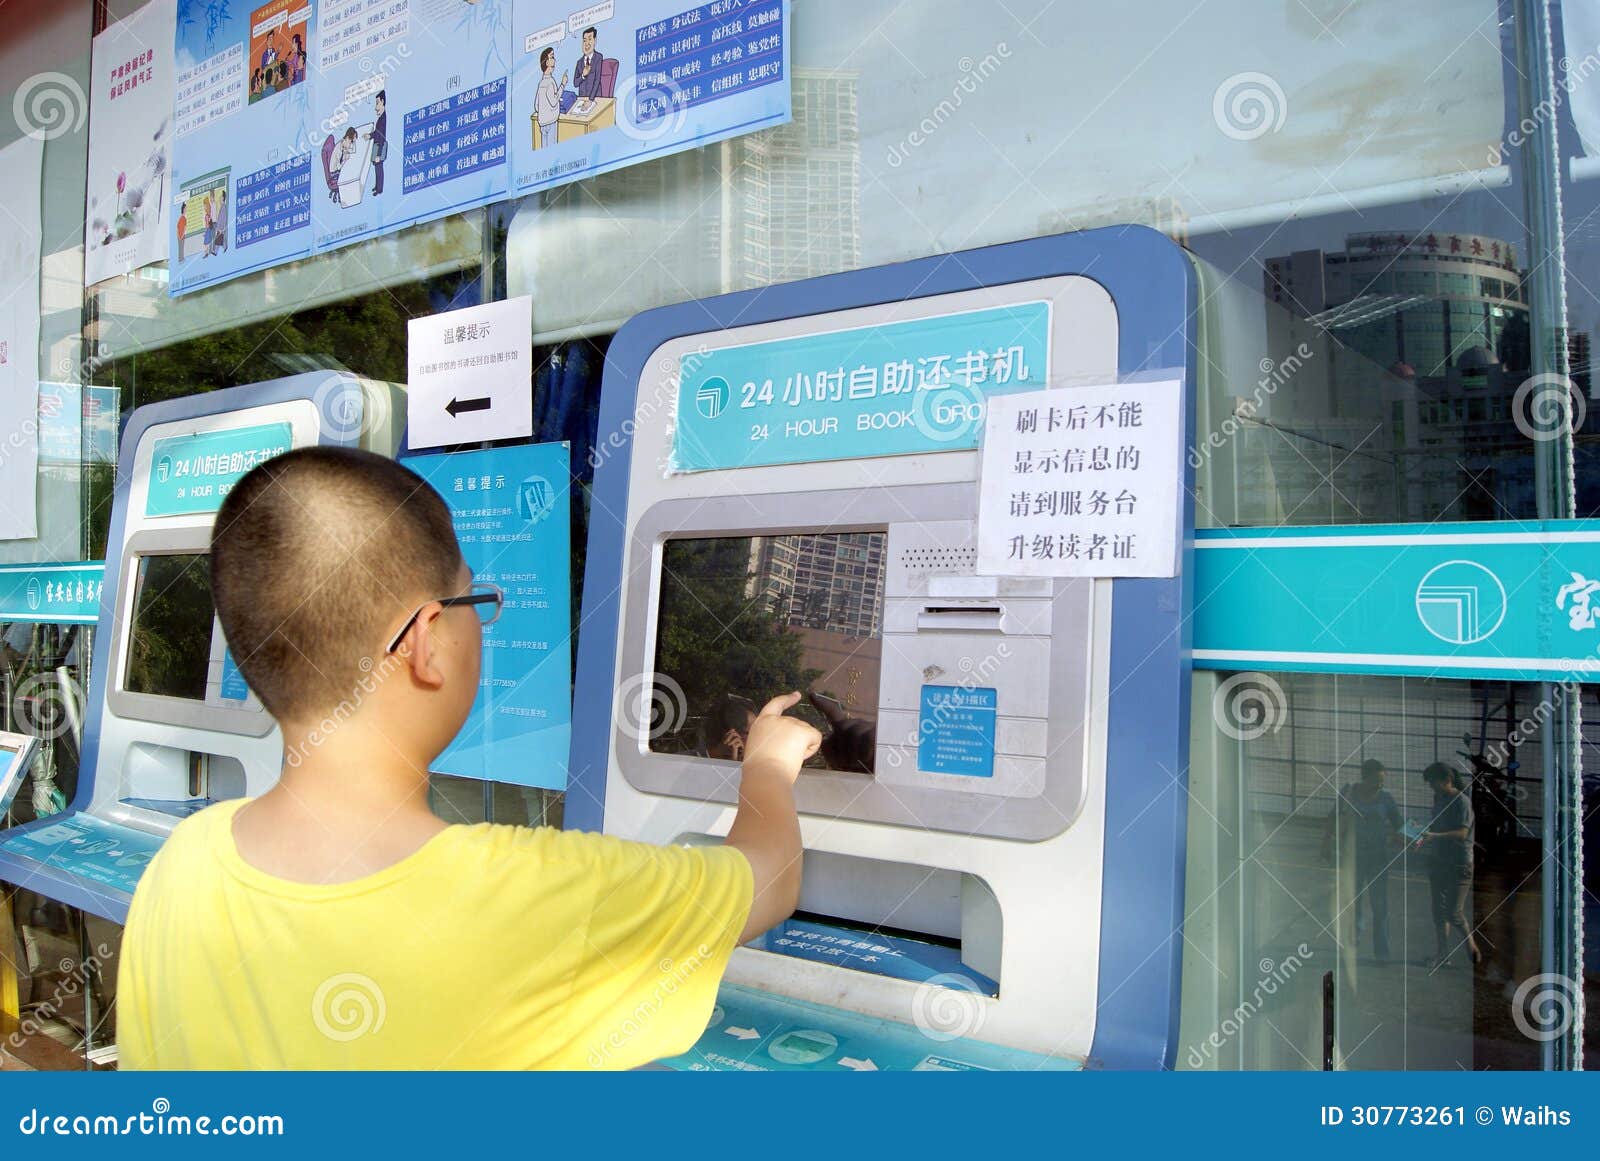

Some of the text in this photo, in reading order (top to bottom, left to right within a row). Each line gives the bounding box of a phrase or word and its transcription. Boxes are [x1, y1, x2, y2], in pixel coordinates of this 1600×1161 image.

[671, 35, 701, 54] 识利害
[711, 20, 742, 42] 高压线
[711, 47, 743, 67] 经考验
[748, 34, 780, 55] 鉴党性
[711, 72, 743, 93] 信组织
[748, 61, 780, 81] 忠职守
[444, 321, 491, 344] 温馨提示
[740, 345, 1028, 409] 24 小时自助还书机
[751, 425, 769, 441] 24
[785, 417, 838, 437] HOUR
[857, 408, 915, 431] BOOK
[1016, 401, 1142, 434] 刷卡后不能
[175, 460, 190, 478] 24
[1013, 445, 1140, 474] 显示信息的
[177, 487, 185, 499] 24
[191, 485, 212, 497] HOUR
[454, 475, 505, 492] 温馨提示
[1009, 489, 1137, 517] 请到服务台
[1008, 533, 1136, 561] 升级读者证
[775, 938, 881, 962] 每次只放一本
